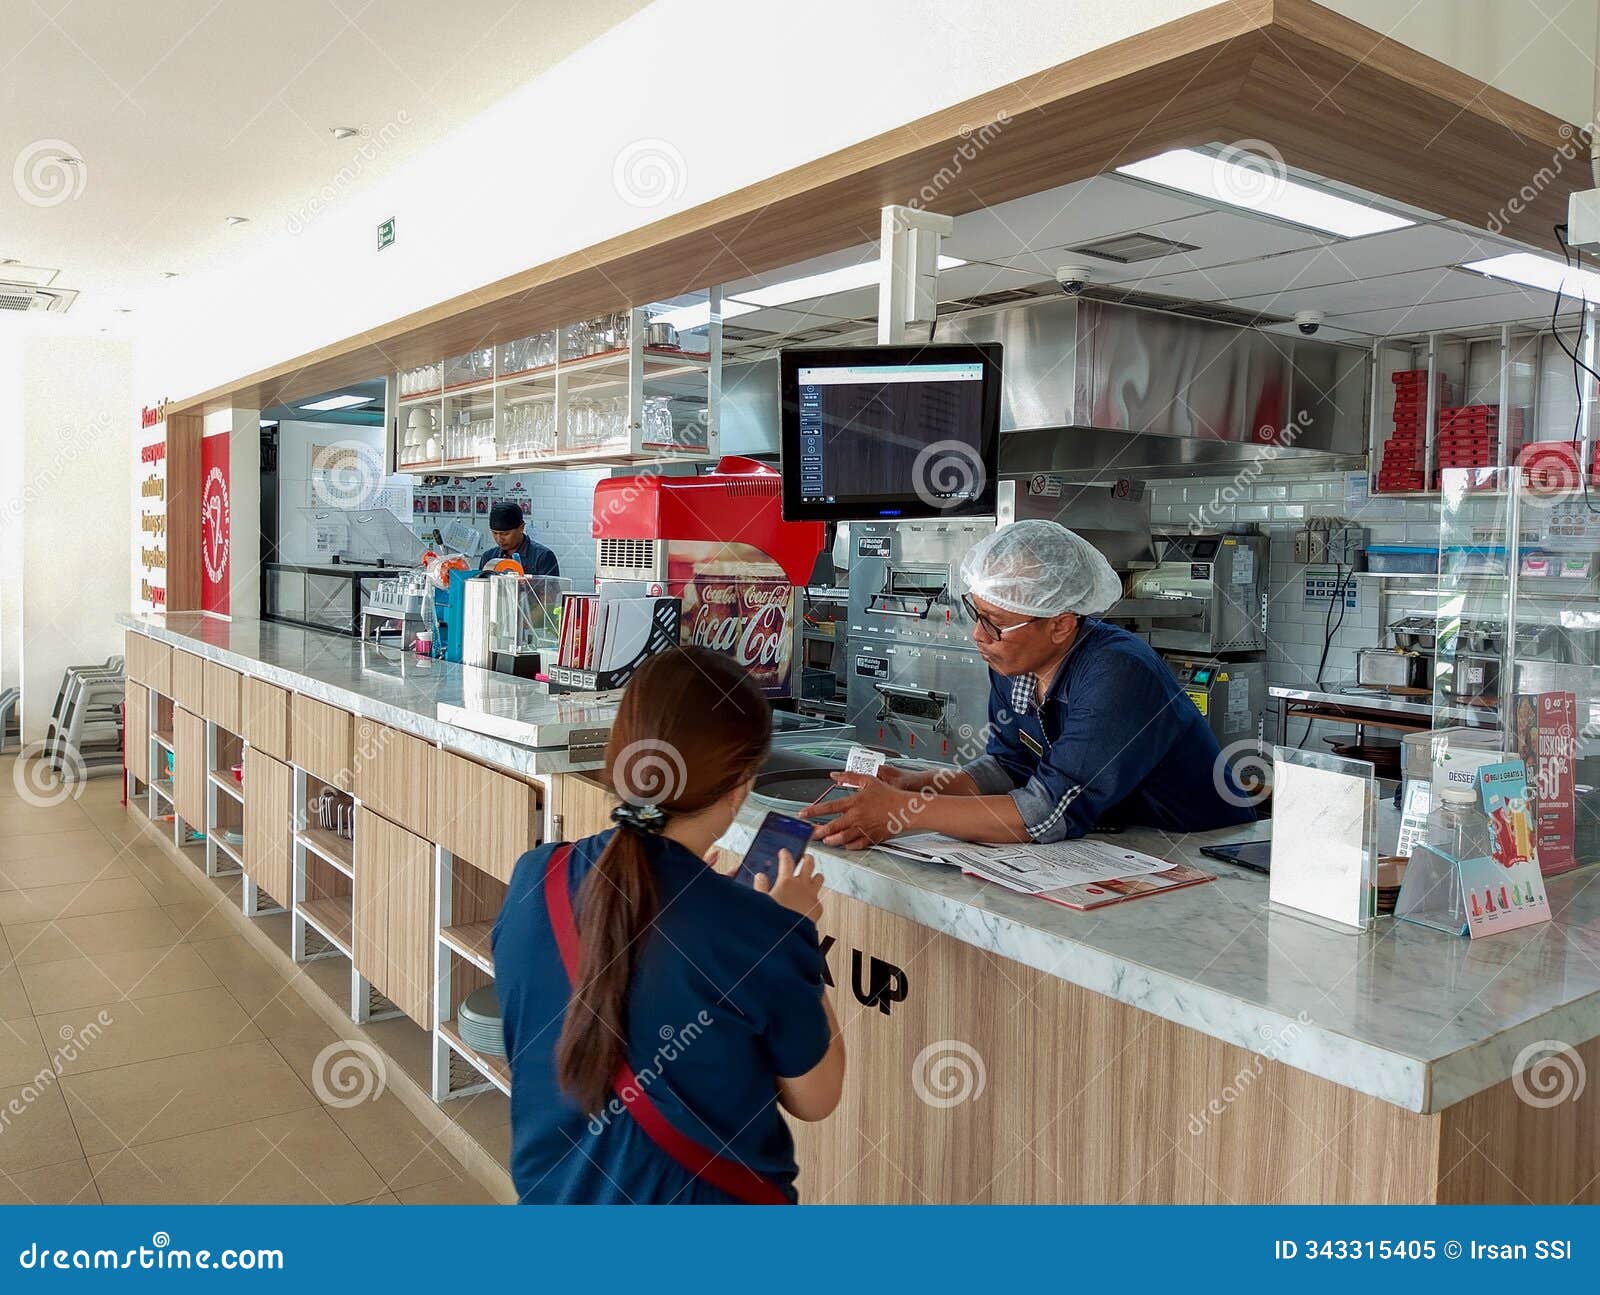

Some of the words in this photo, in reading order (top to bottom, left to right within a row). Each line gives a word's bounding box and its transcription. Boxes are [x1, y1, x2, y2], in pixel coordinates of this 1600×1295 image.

[152, 586, 165, 608] pizz
[692, 603, 787, 666] Coca-Col
[1503, 770, 1520, 779] GRATIS
[851, 948, 909, 1016] UP
